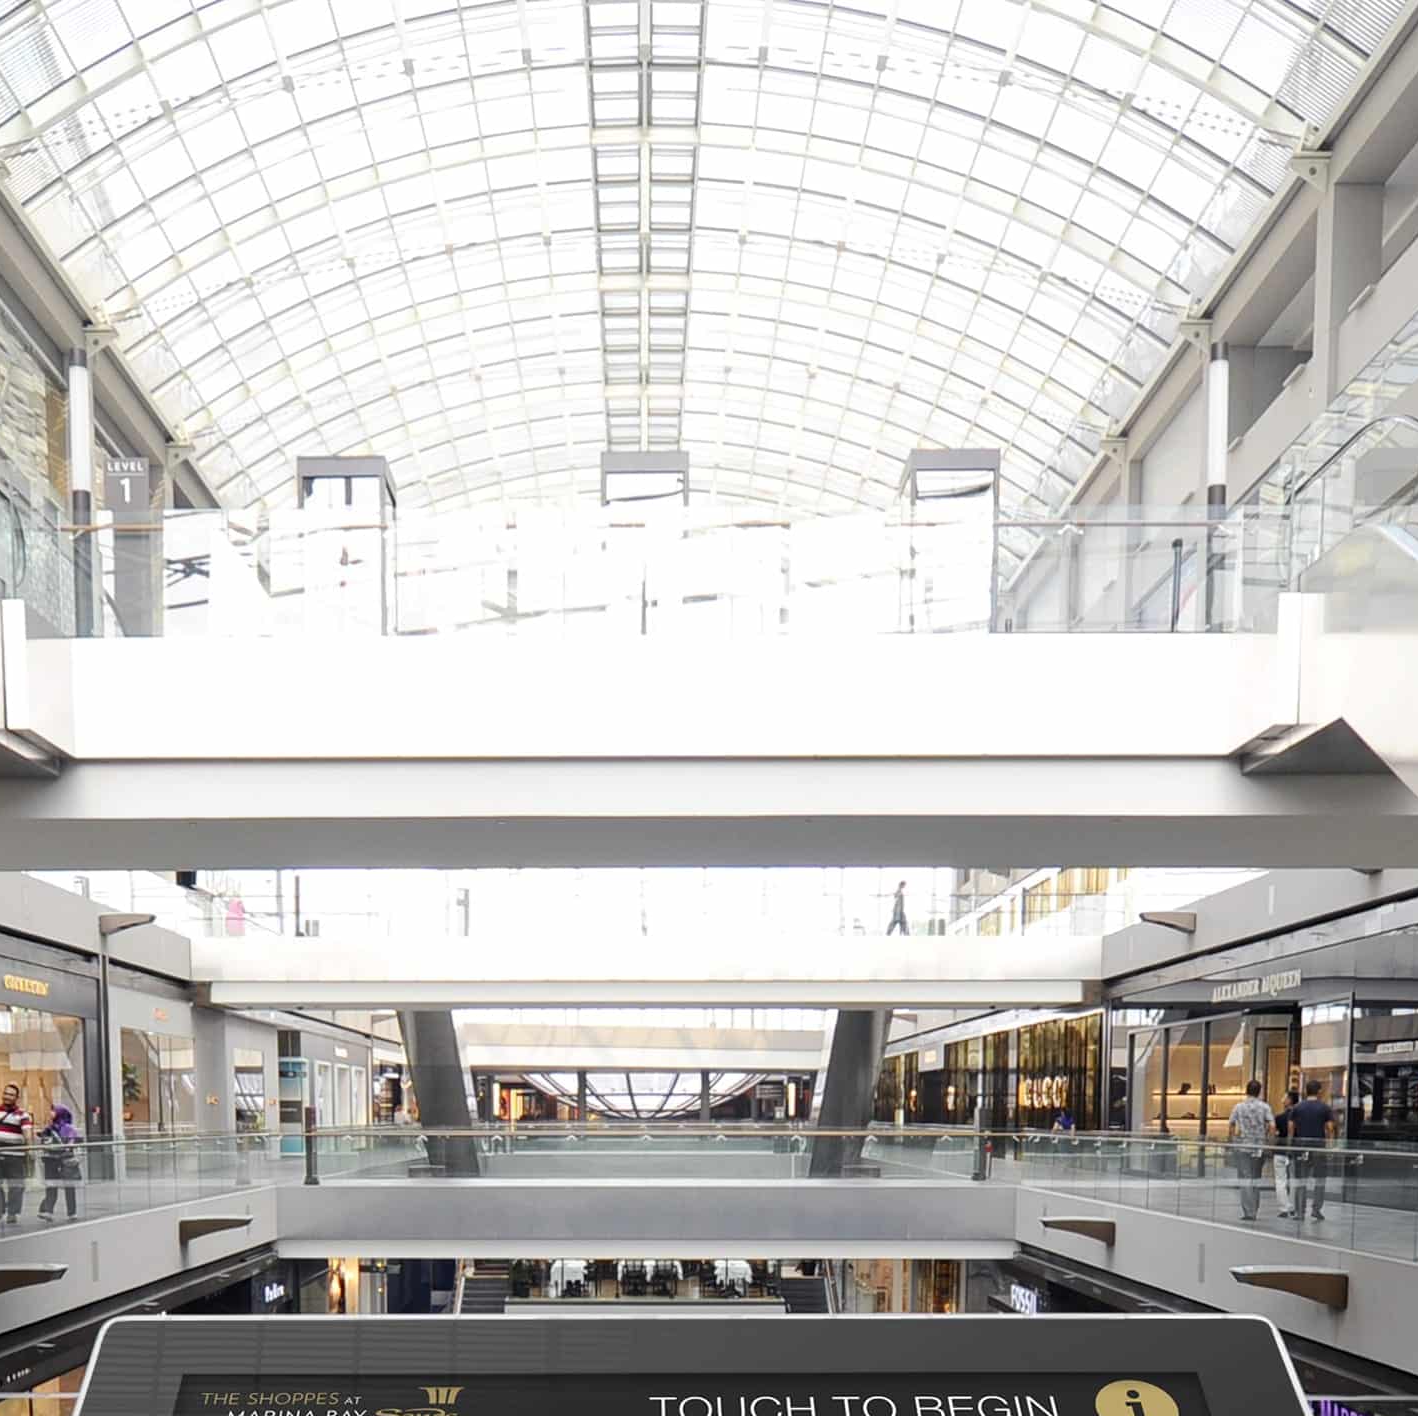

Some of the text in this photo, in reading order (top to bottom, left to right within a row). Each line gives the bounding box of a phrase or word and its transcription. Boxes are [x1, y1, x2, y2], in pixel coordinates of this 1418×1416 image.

[106, 461, 144, 472] LEVEL
[120, 477, 131, 503] 1
[201, 1392, 241, 1406] THE
[246, 1392, 340, 1406] SHOPPES
